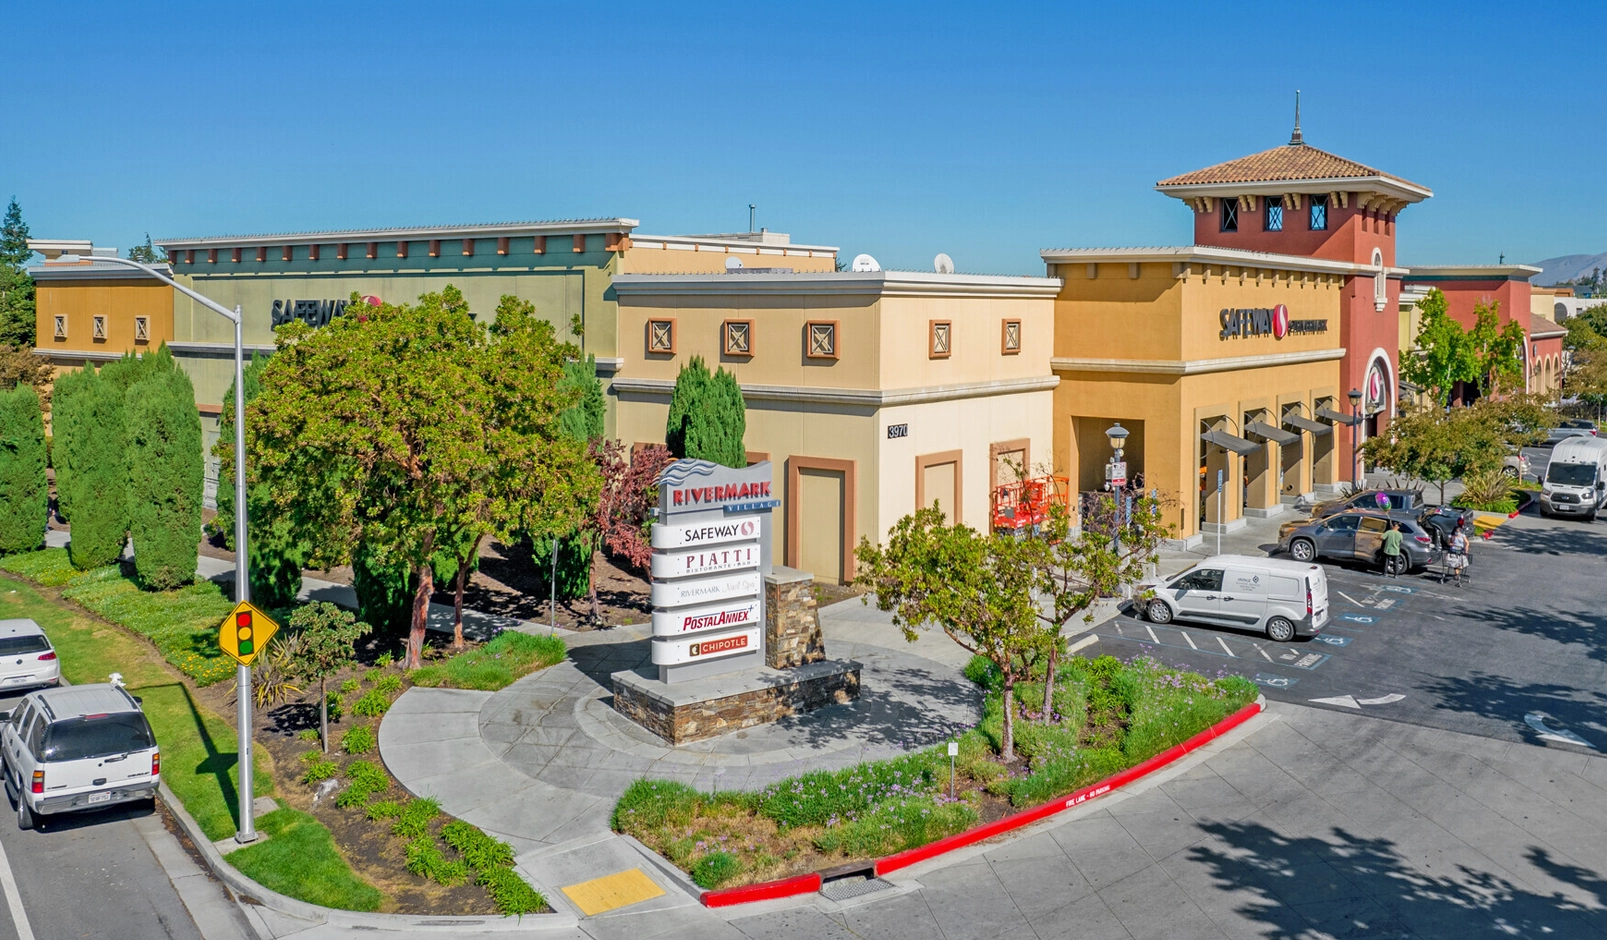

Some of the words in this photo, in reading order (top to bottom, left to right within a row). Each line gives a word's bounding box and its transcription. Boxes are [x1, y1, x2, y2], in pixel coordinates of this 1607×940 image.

[271, 299, 355, 331] SAFEWA
[889, 424, 908, 438] 3970
[673, 481, 772, 505] RIVERMARK
[685, 524, 739, 542] SAFEWAY
[686, 548, 751, 569] PIATTI
[686, 563, 731, 573] RISTORANTE
[680, 585, 720, 598] RIVERMARK
[702, 637, 746, 653] CHIPOTLE
